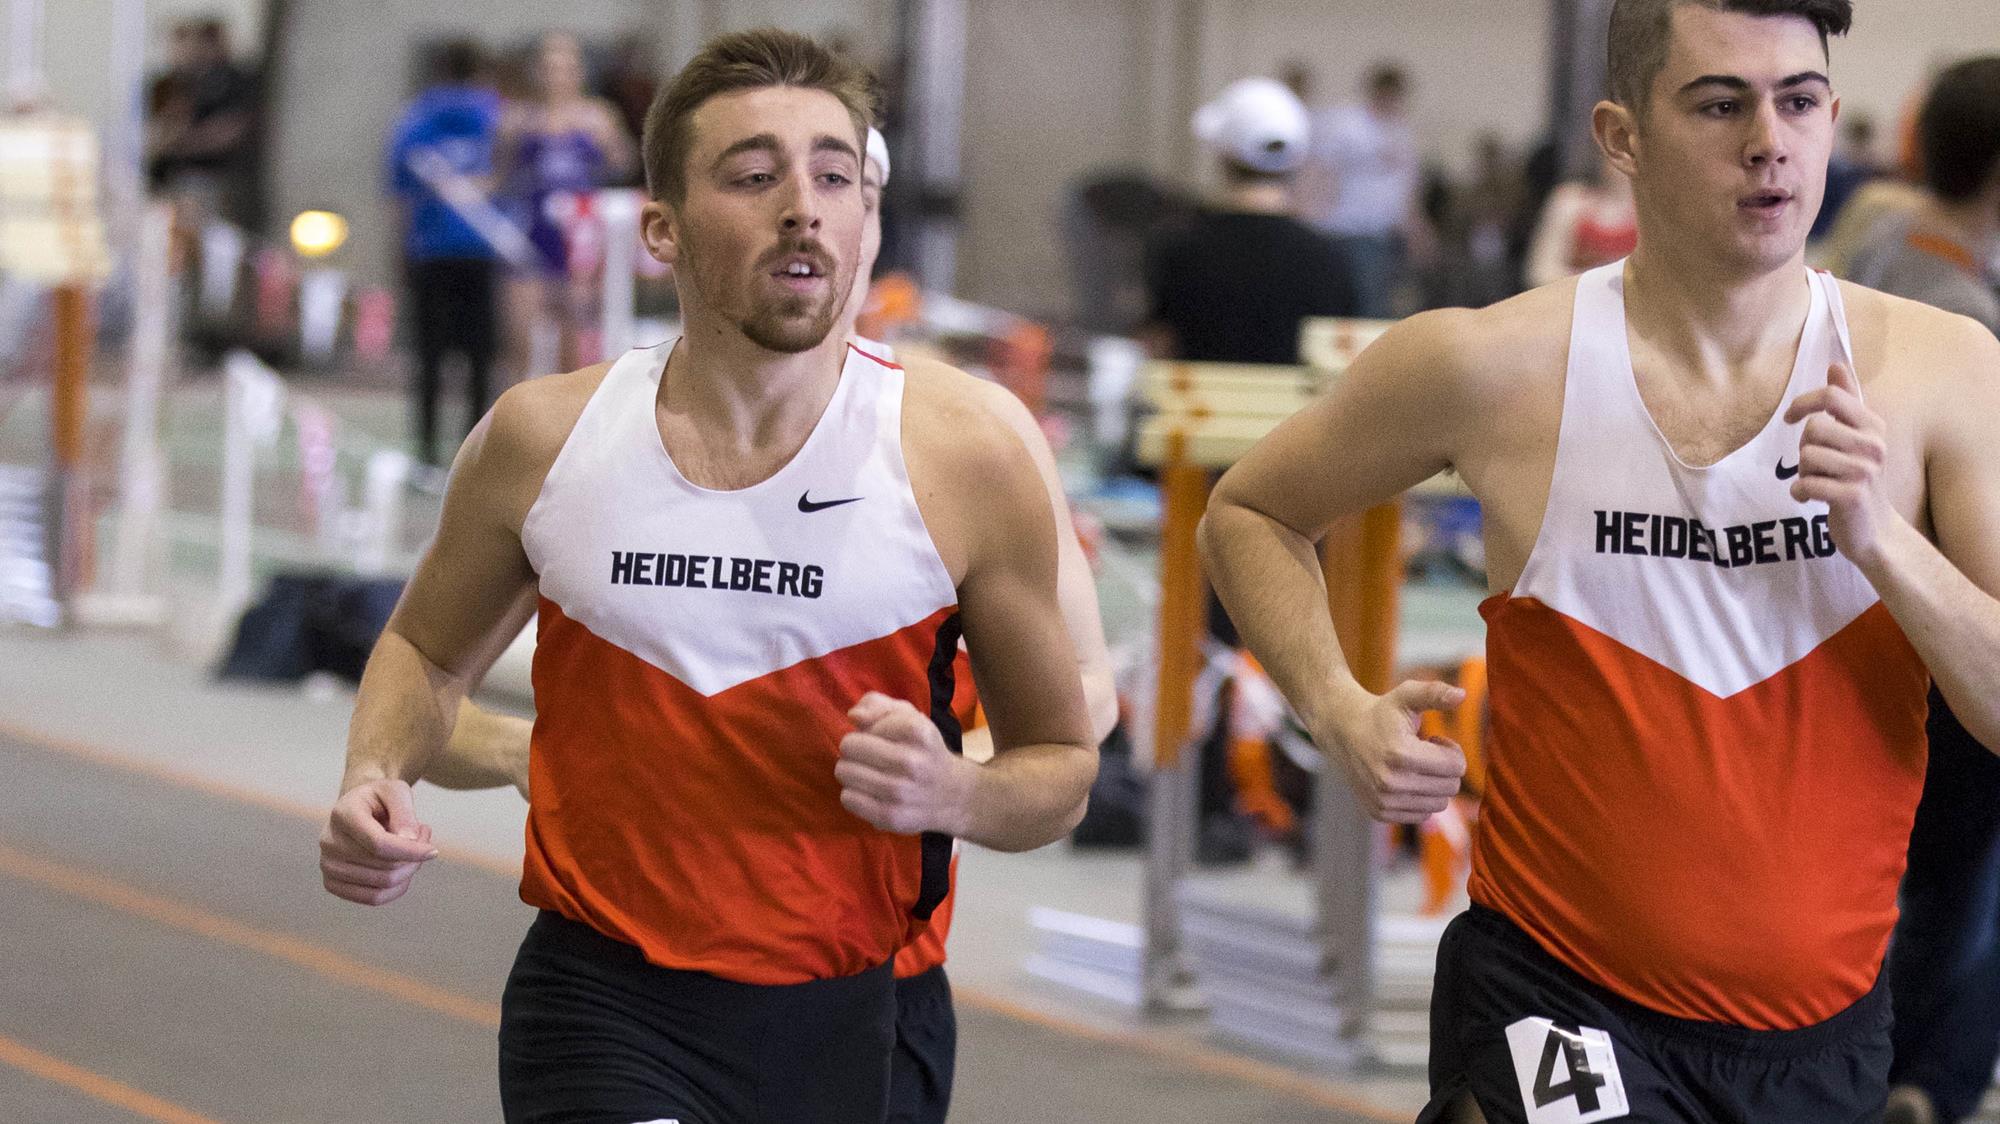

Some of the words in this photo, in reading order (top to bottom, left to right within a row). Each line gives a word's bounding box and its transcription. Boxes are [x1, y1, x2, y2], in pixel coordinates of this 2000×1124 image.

[1593, 510, 1836, 568] HEIDELBERG
[611, 551, 824, 599] HEIDELBERG
[1533, 1021, 1606, 1115] 4
